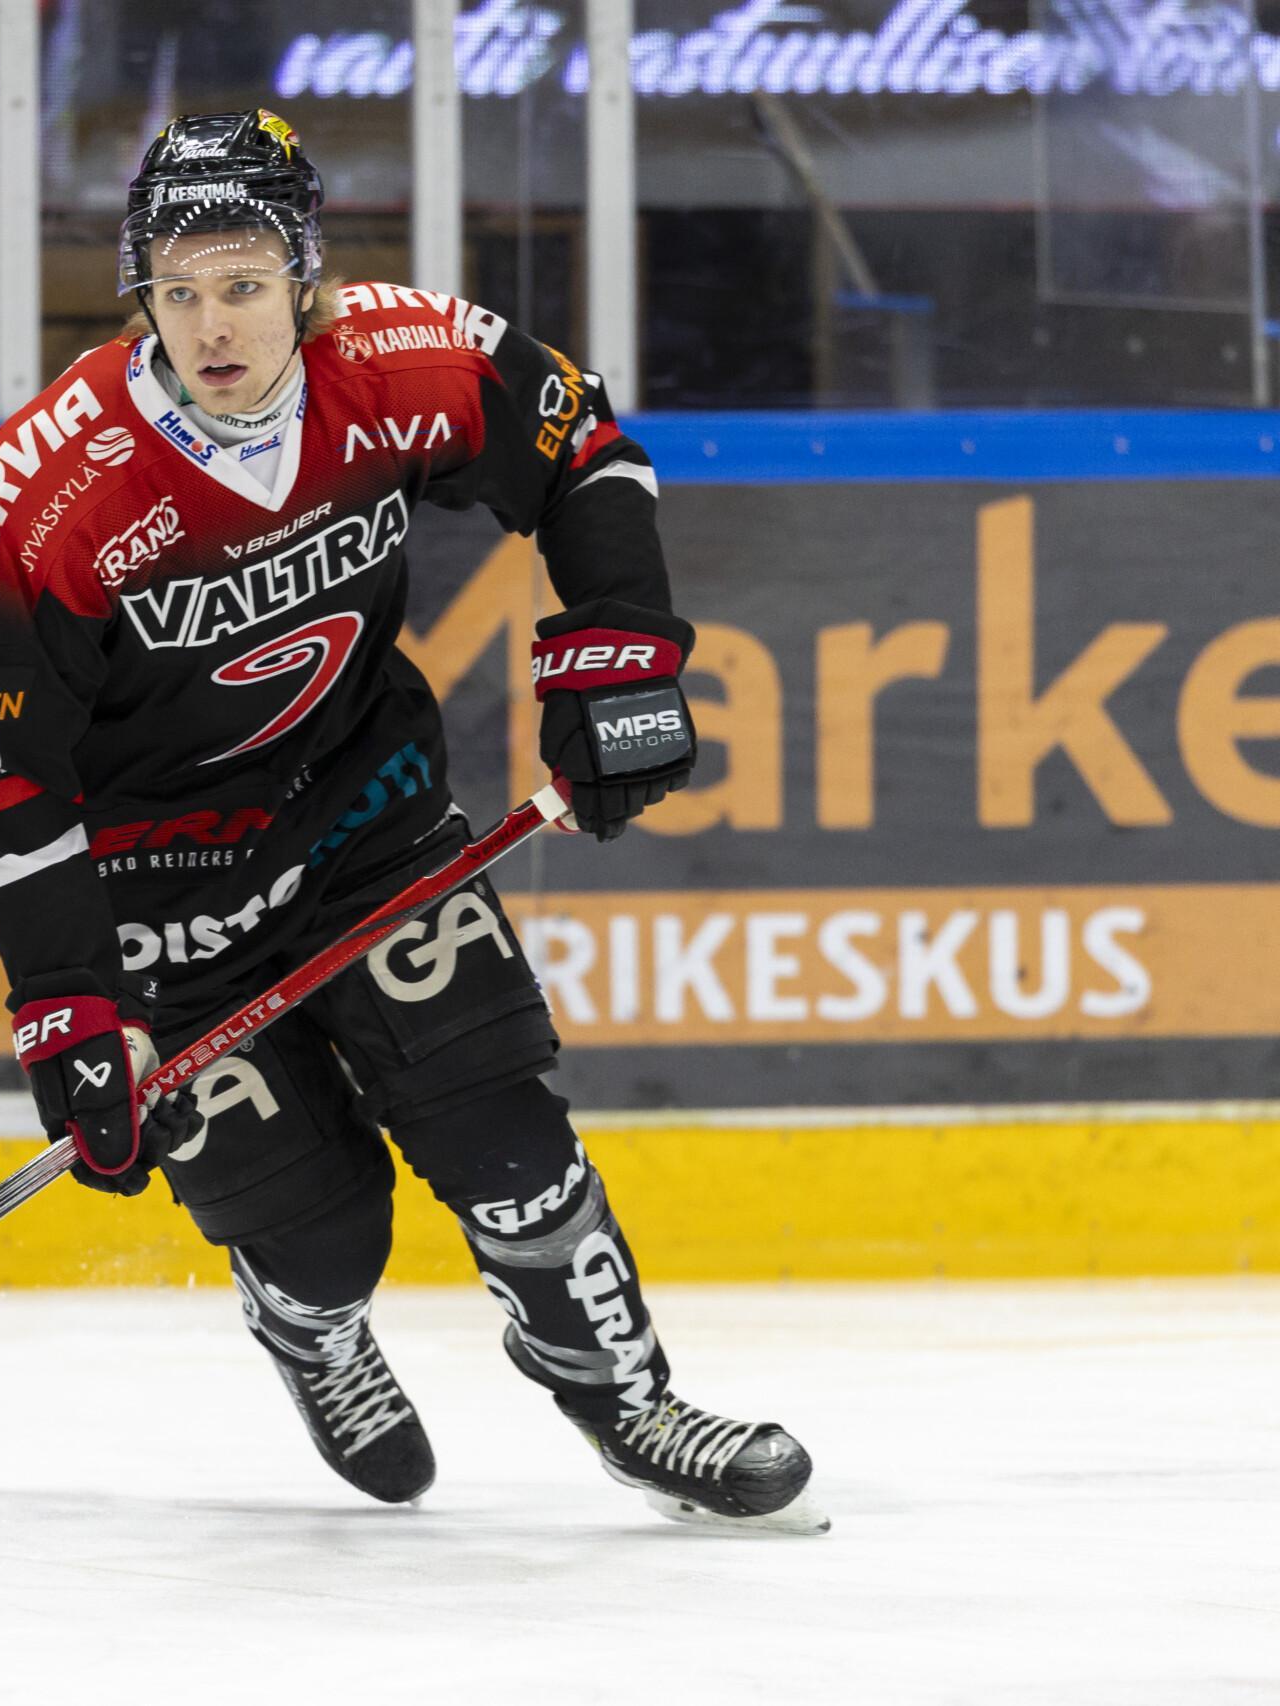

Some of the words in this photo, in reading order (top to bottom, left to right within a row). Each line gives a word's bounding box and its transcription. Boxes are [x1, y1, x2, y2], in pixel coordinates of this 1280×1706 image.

[334, 282, 508, 356] ARVIA
[370, 324, 454, 355] KARJALA
[158, 409, 218, 462] HIMOS
[20, 460, 102, 573] JYVÄSKYLÄ
[245, 501, 332, 555] BAUER
[120, 489, 409, 650] VALTRA
[532, 644, 656, 686] AUER
[595, 709, 682, 742] MPS
[601, 731, 686, 753] MOTORS
[521, 905, 1152, 1026] RIKESKUS
[13, 1007, 73, 1060] ER
